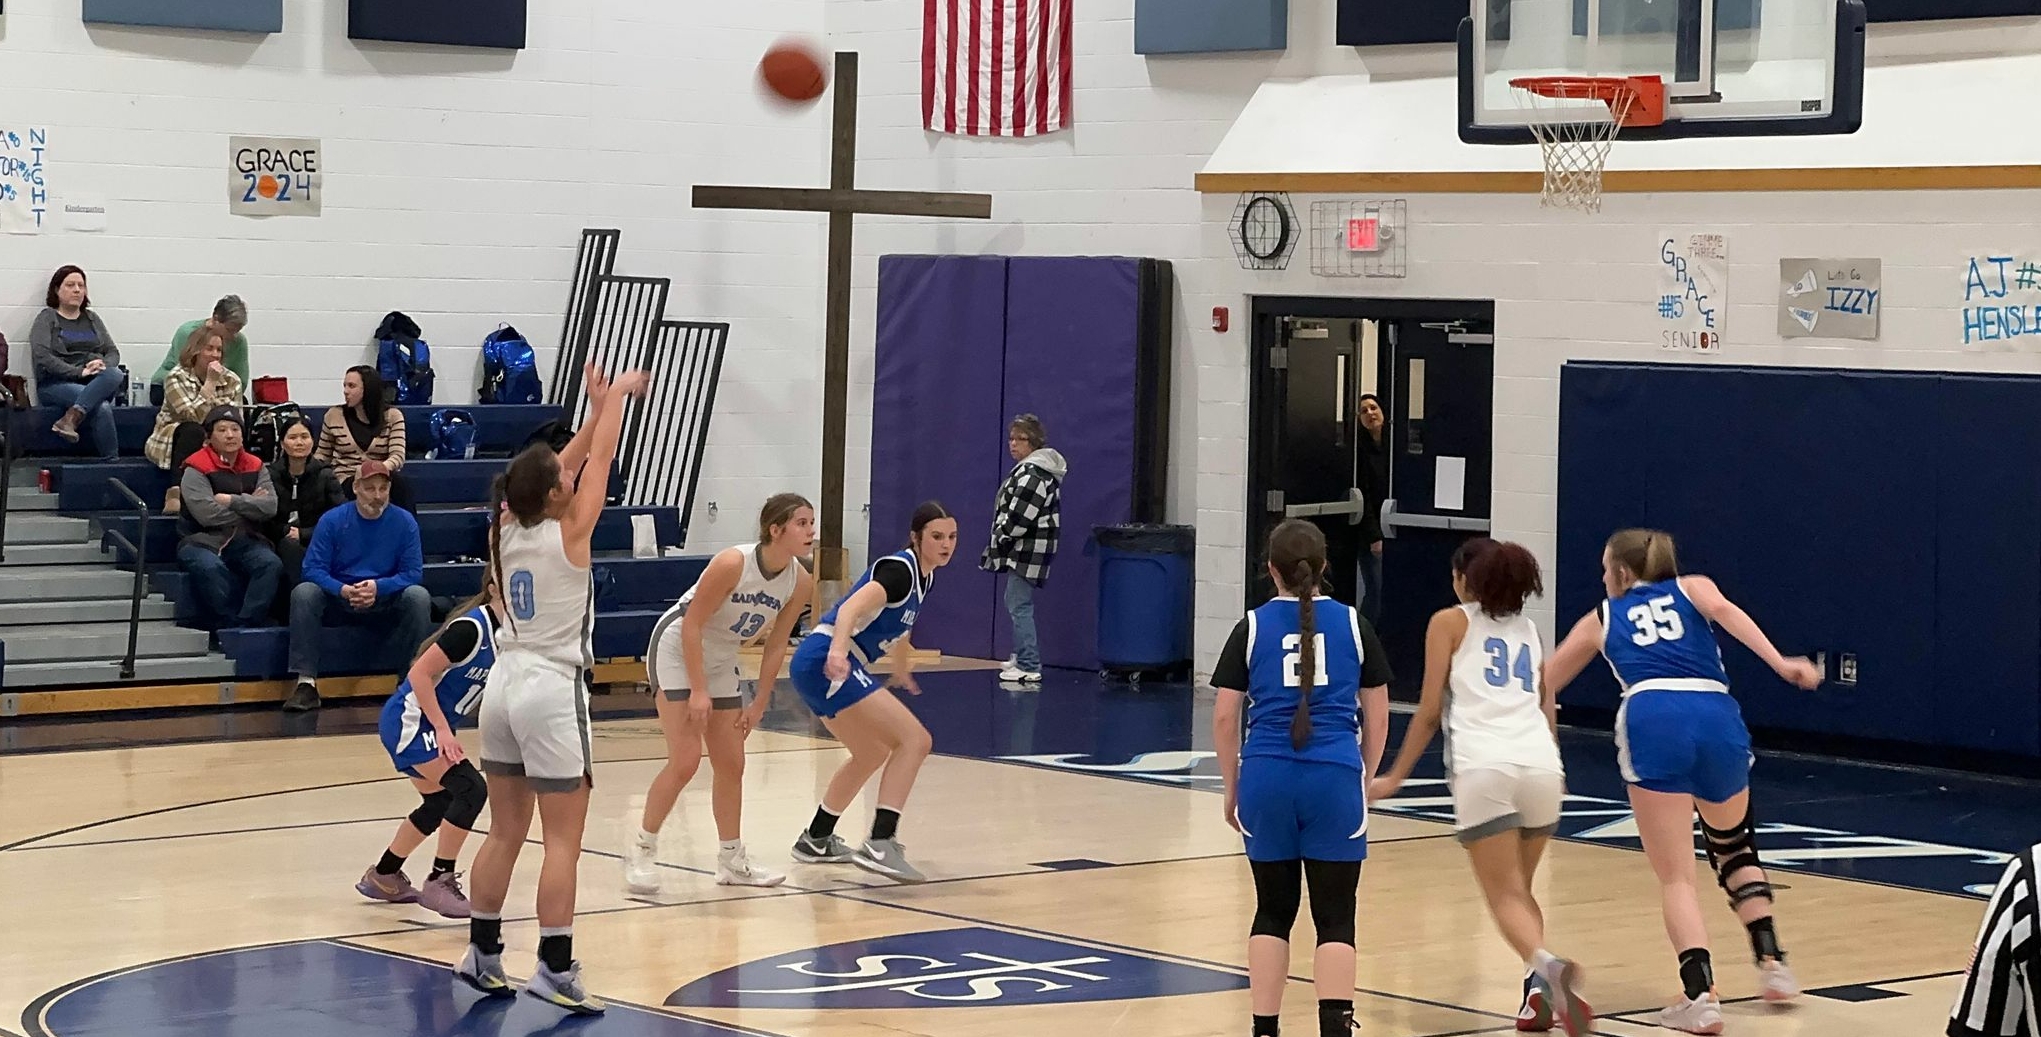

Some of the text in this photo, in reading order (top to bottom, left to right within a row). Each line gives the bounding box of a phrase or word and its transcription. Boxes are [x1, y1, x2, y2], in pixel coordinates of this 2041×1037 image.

[30, 128, 45, 228] NIGHT
[236, 148, 316, 173] GRACE
[1661, 238, 1714, 328] GRACE
[1965, 256, 2013, 301] AJ
[1658, 295, 1684, 319] #5
[1824, 286, 1878, 315] IZZY
[1662, 330, 1720, 350] SENIOR
[509, 569, 535, 621] 0
[729, 611, 766, 638] 13
[1626, 593, 1685, 647] 35
[464, 666, 491, 683] MAP
[1282, 632, 1329, 687] 21
[1484, 636, 1534, 693] 34
[422, 730, 438, 751] M
